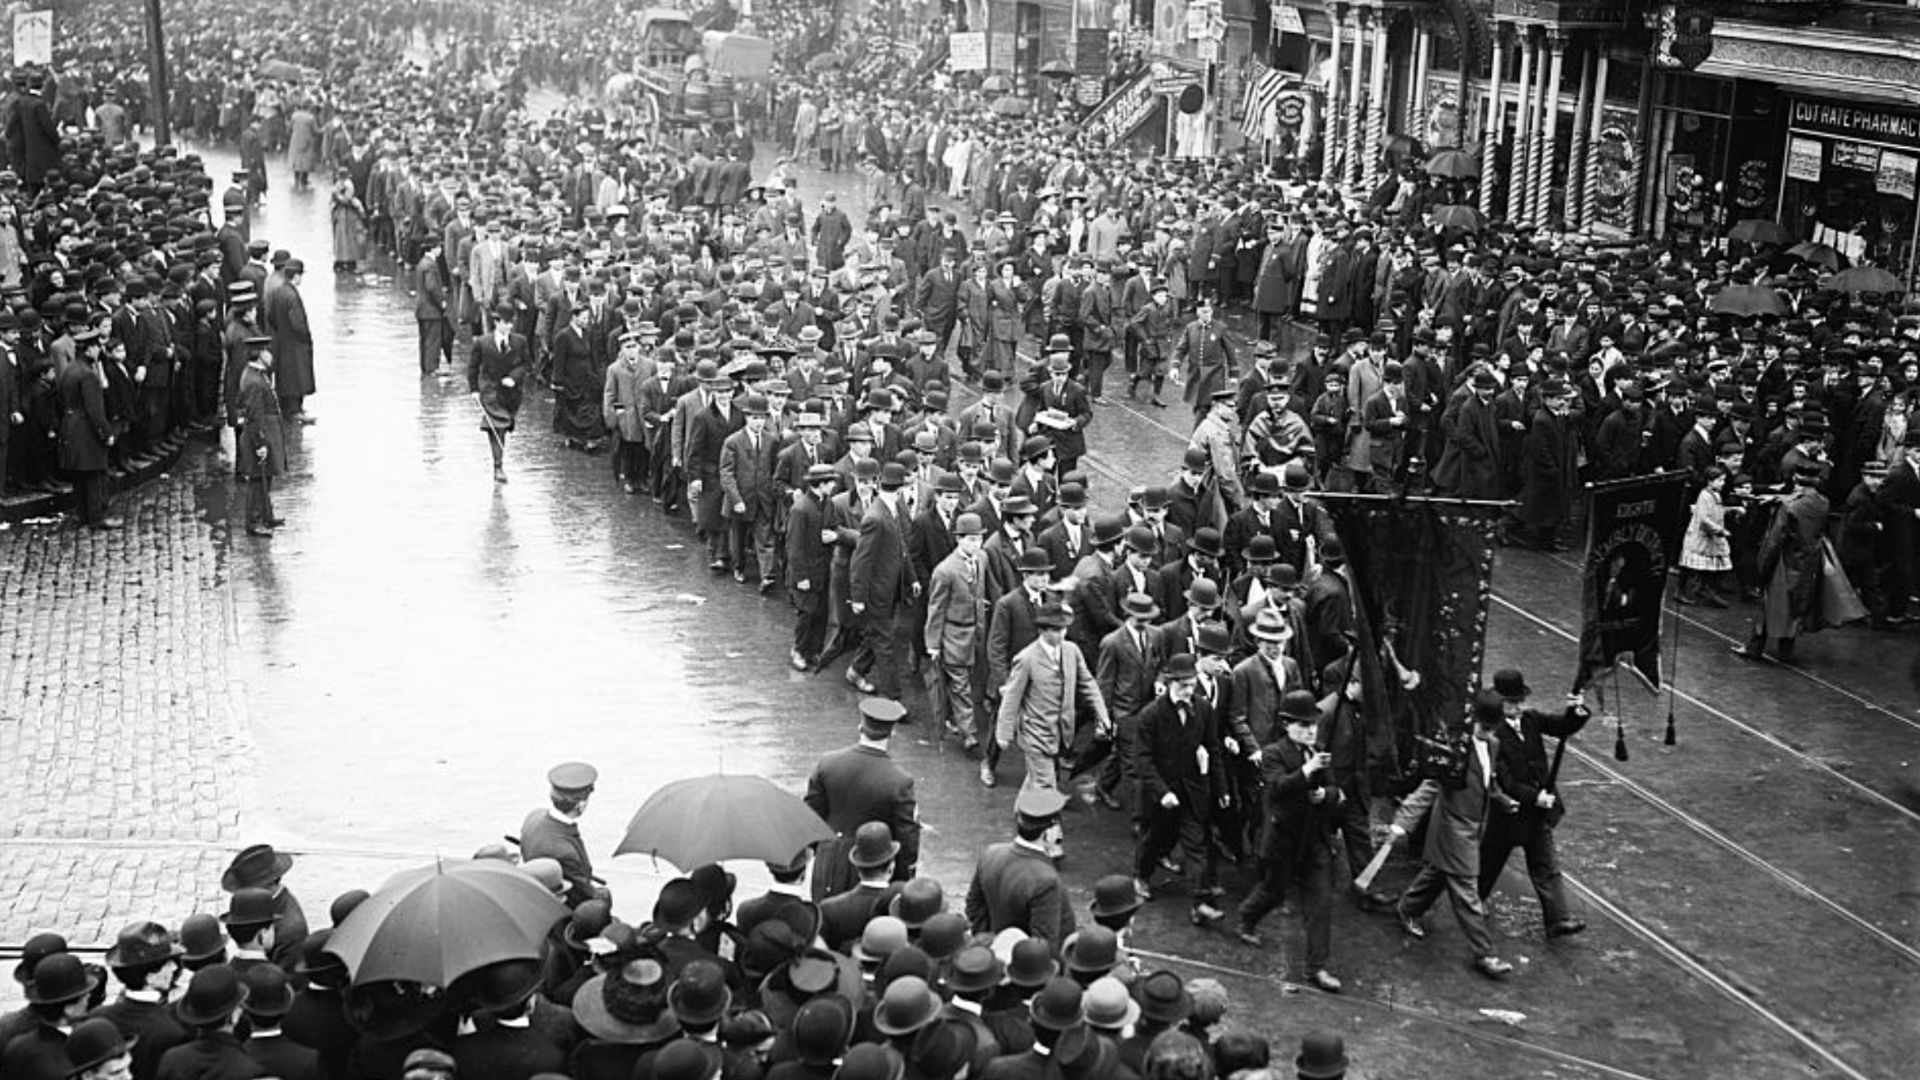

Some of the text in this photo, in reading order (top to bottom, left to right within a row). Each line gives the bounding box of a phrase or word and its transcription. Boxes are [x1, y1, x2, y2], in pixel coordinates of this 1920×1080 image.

[1796, 102, 1920, 138] CUT RATE PHARMAC
